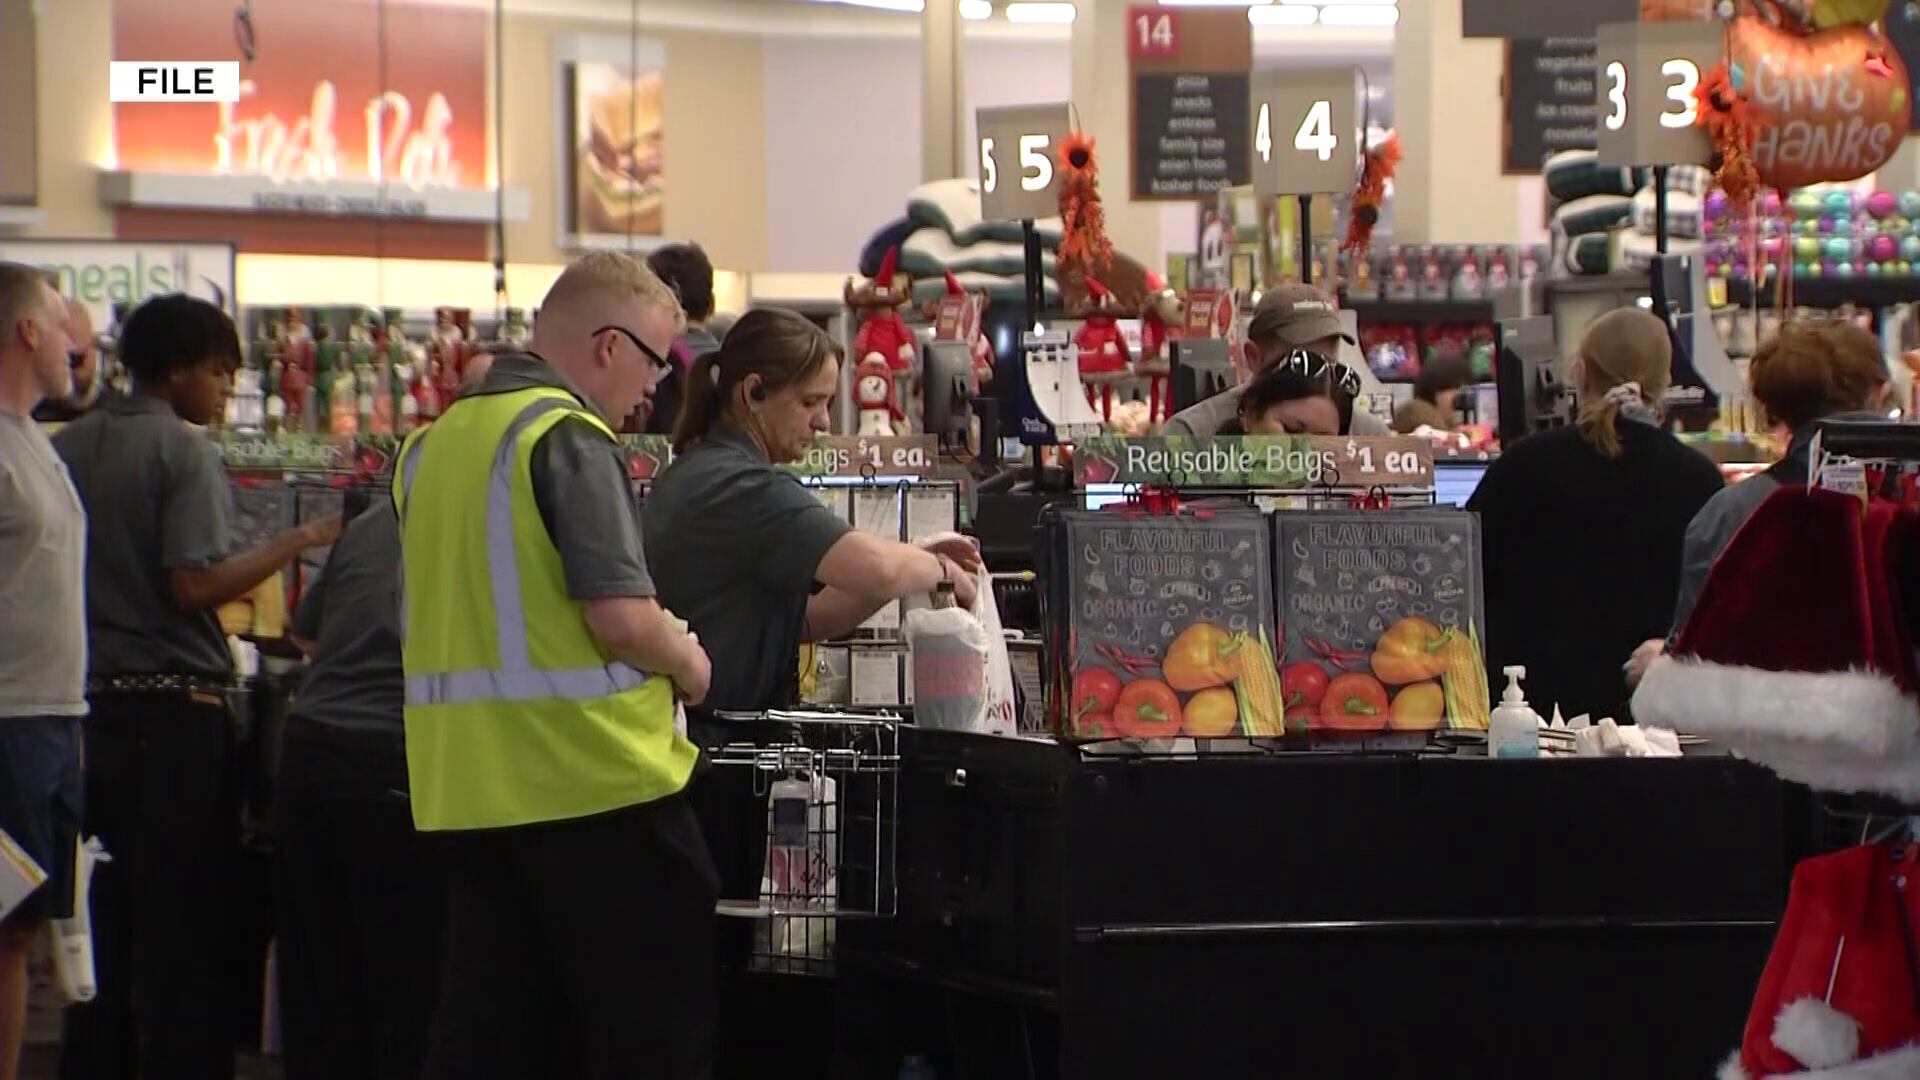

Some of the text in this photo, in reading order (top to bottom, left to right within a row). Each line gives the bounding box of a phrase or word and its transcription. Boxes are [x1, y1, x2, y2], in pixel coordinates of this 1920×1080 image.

[1136, 14, 1173, 48] 14
[1606, 60, 1627, 130] 3
[1660, 59, 1699, 128] 3
[1255, 102, 1272, 164] 4
[1294, 100, 1337, 161] 4
[982, 138, 997, 192] 5
[1020, 134, 1053, 191] 5
[858, 440, 883, 467] $1
[892, 447, 931, 467] ea.
[1127, 439, 1427, 480] Reusable Bags $1 ea.
[1100, 528, 1226, 552] FLAVORFUL
[1309, 522, 1441, 546] FLAVORFUL
[1113, 555, 1197, 577] FOODS
[1323, 550, 1408, 571] FOODS
[1082, 599, 1160, 619] ORGANIC
[1291, 593, 1367, 612] ORGANIC
